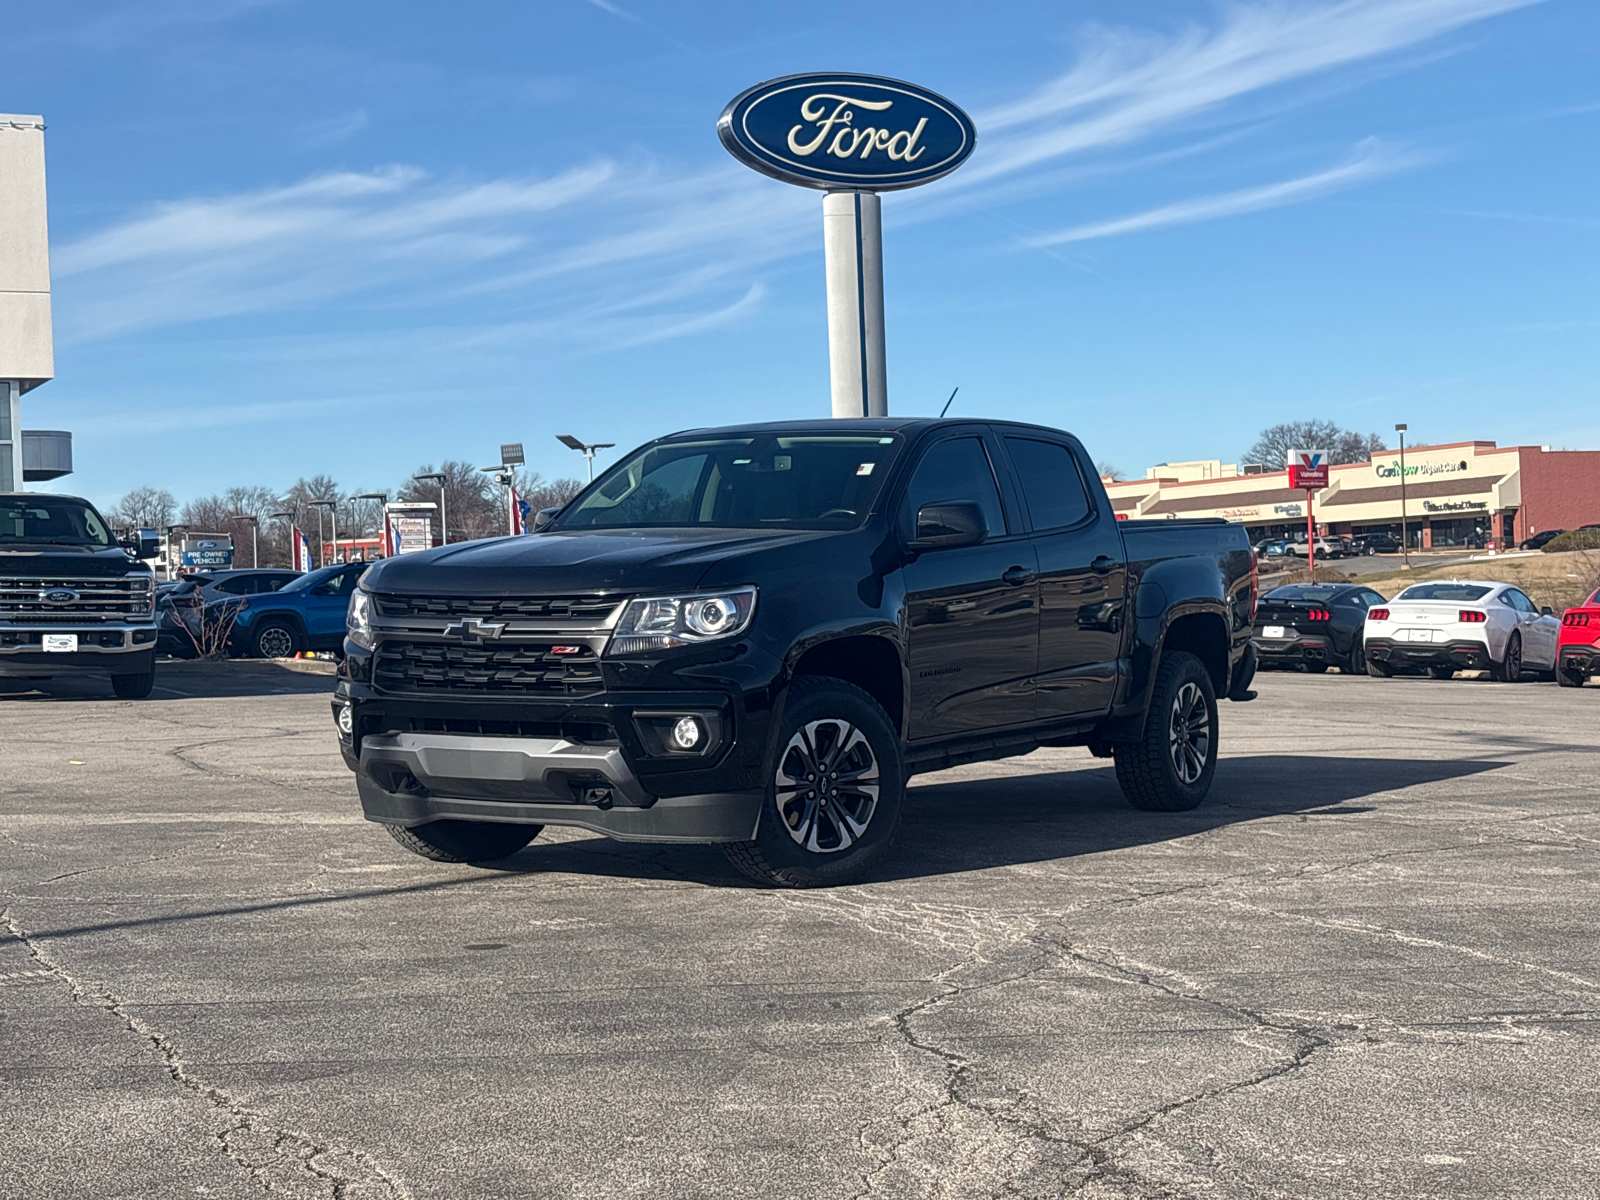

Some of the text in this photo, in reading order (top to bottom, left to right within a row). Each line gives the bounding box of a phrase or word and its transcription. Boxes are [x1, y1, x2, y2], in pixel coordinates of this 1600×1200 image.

[787, 93, 929, 162] Ford
[51, 592, 70, 601] Ford
[551, 645, 580, 654] Z71
